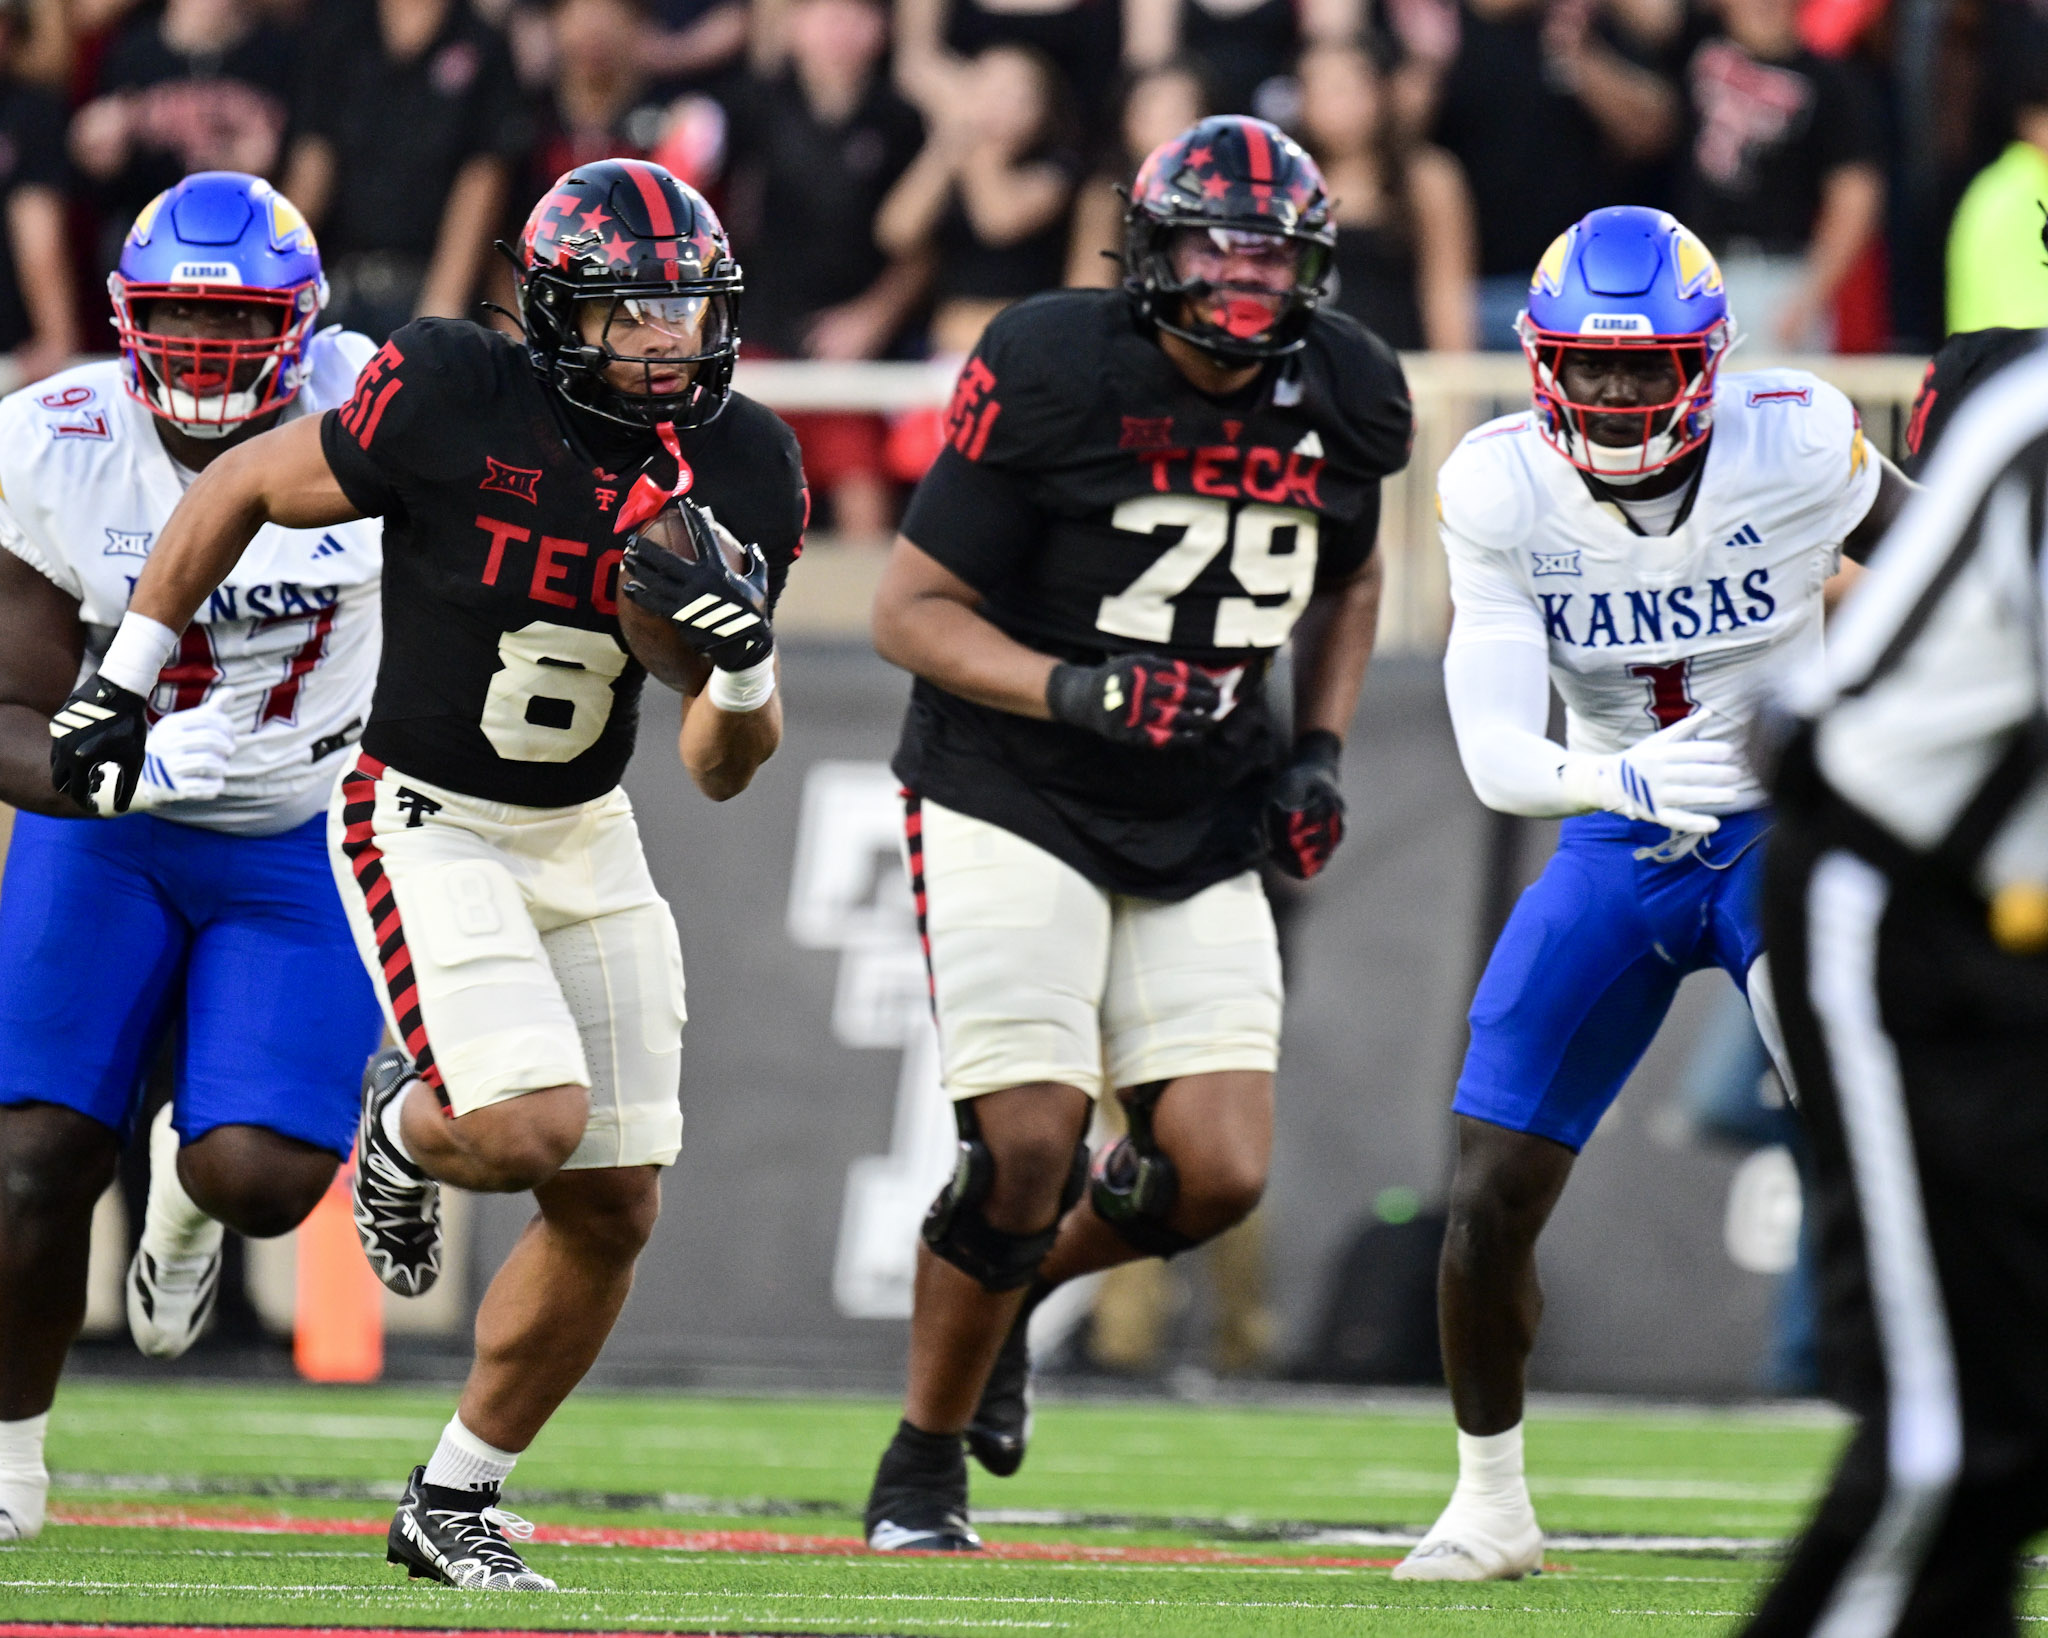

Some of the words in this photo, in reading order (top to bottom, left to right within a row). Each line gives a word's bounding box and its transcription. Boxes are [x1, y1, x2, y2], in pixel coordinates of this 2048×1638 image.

[183, 266, 227, 277] KANSAS
[1593, 318, 1638, 330] KANSAS
[33, 385, 114, 442] 97
[1136, 445, 1329, 509] TECH
[474, 513, 624, 616] TEC
[1095, 493, 1320, 648] 79
[1537, 567, 1776, 648] KANSAS
[479, 620, 629, 764] 8
[446, 868, 504, 937] 8
